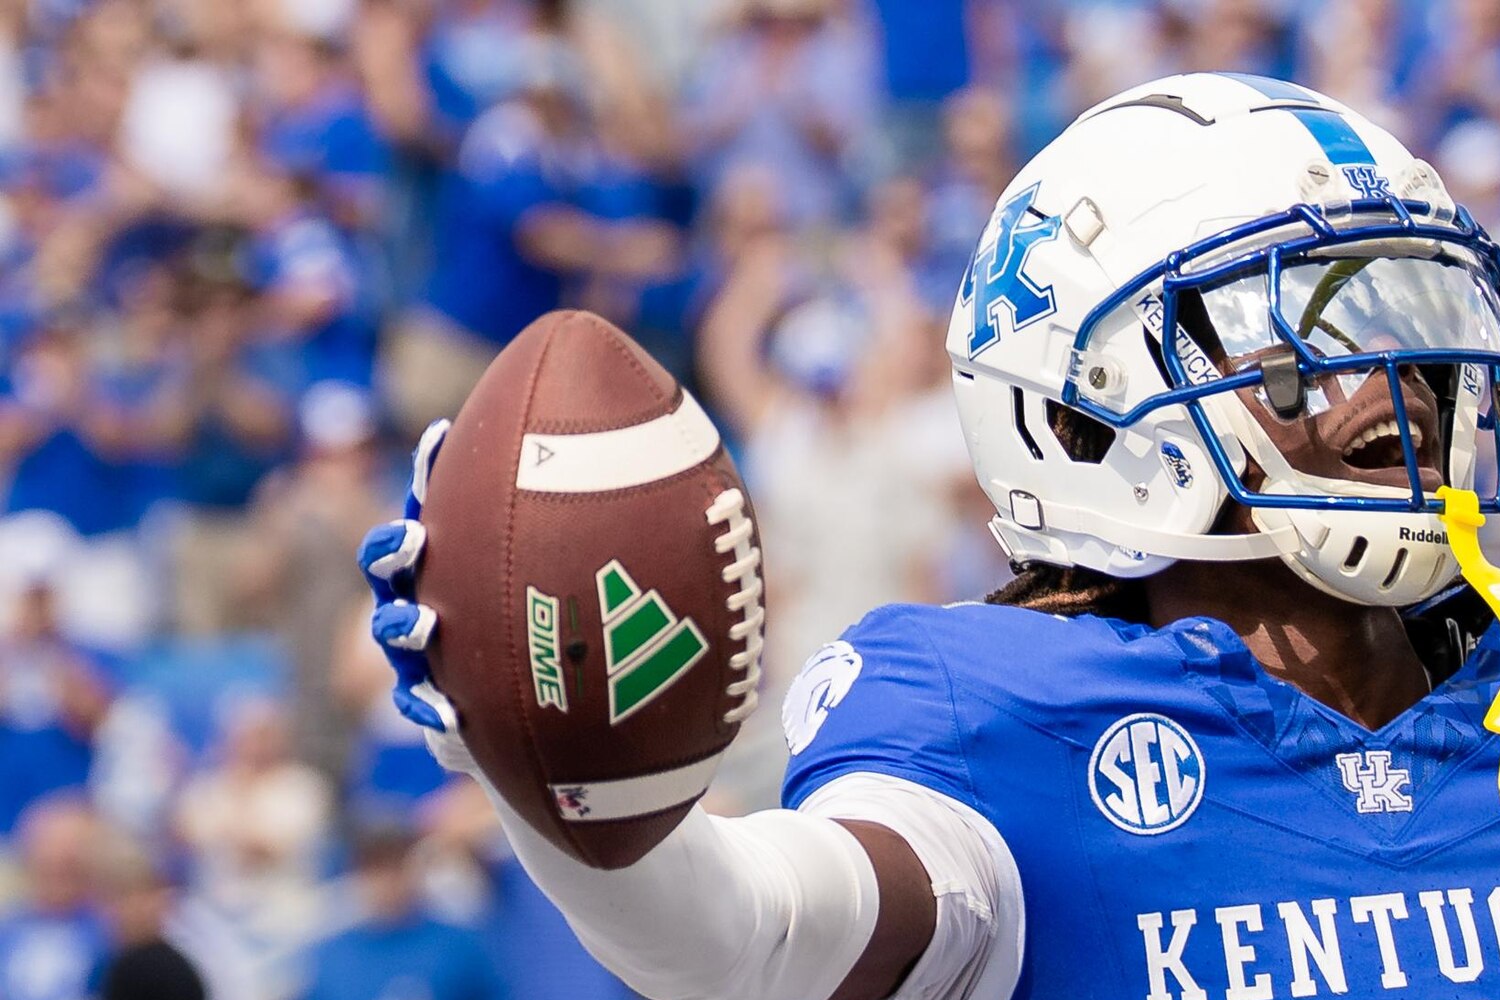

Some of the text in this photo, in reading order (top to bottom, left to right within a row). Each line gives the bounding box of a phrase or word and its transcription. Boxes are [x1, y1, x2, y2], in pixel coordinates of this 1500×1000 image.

[526, 585, 568, 714] DIME
[1097, 720, 1198, 828] SEC
[1336, 751, 1413, 814] UK
